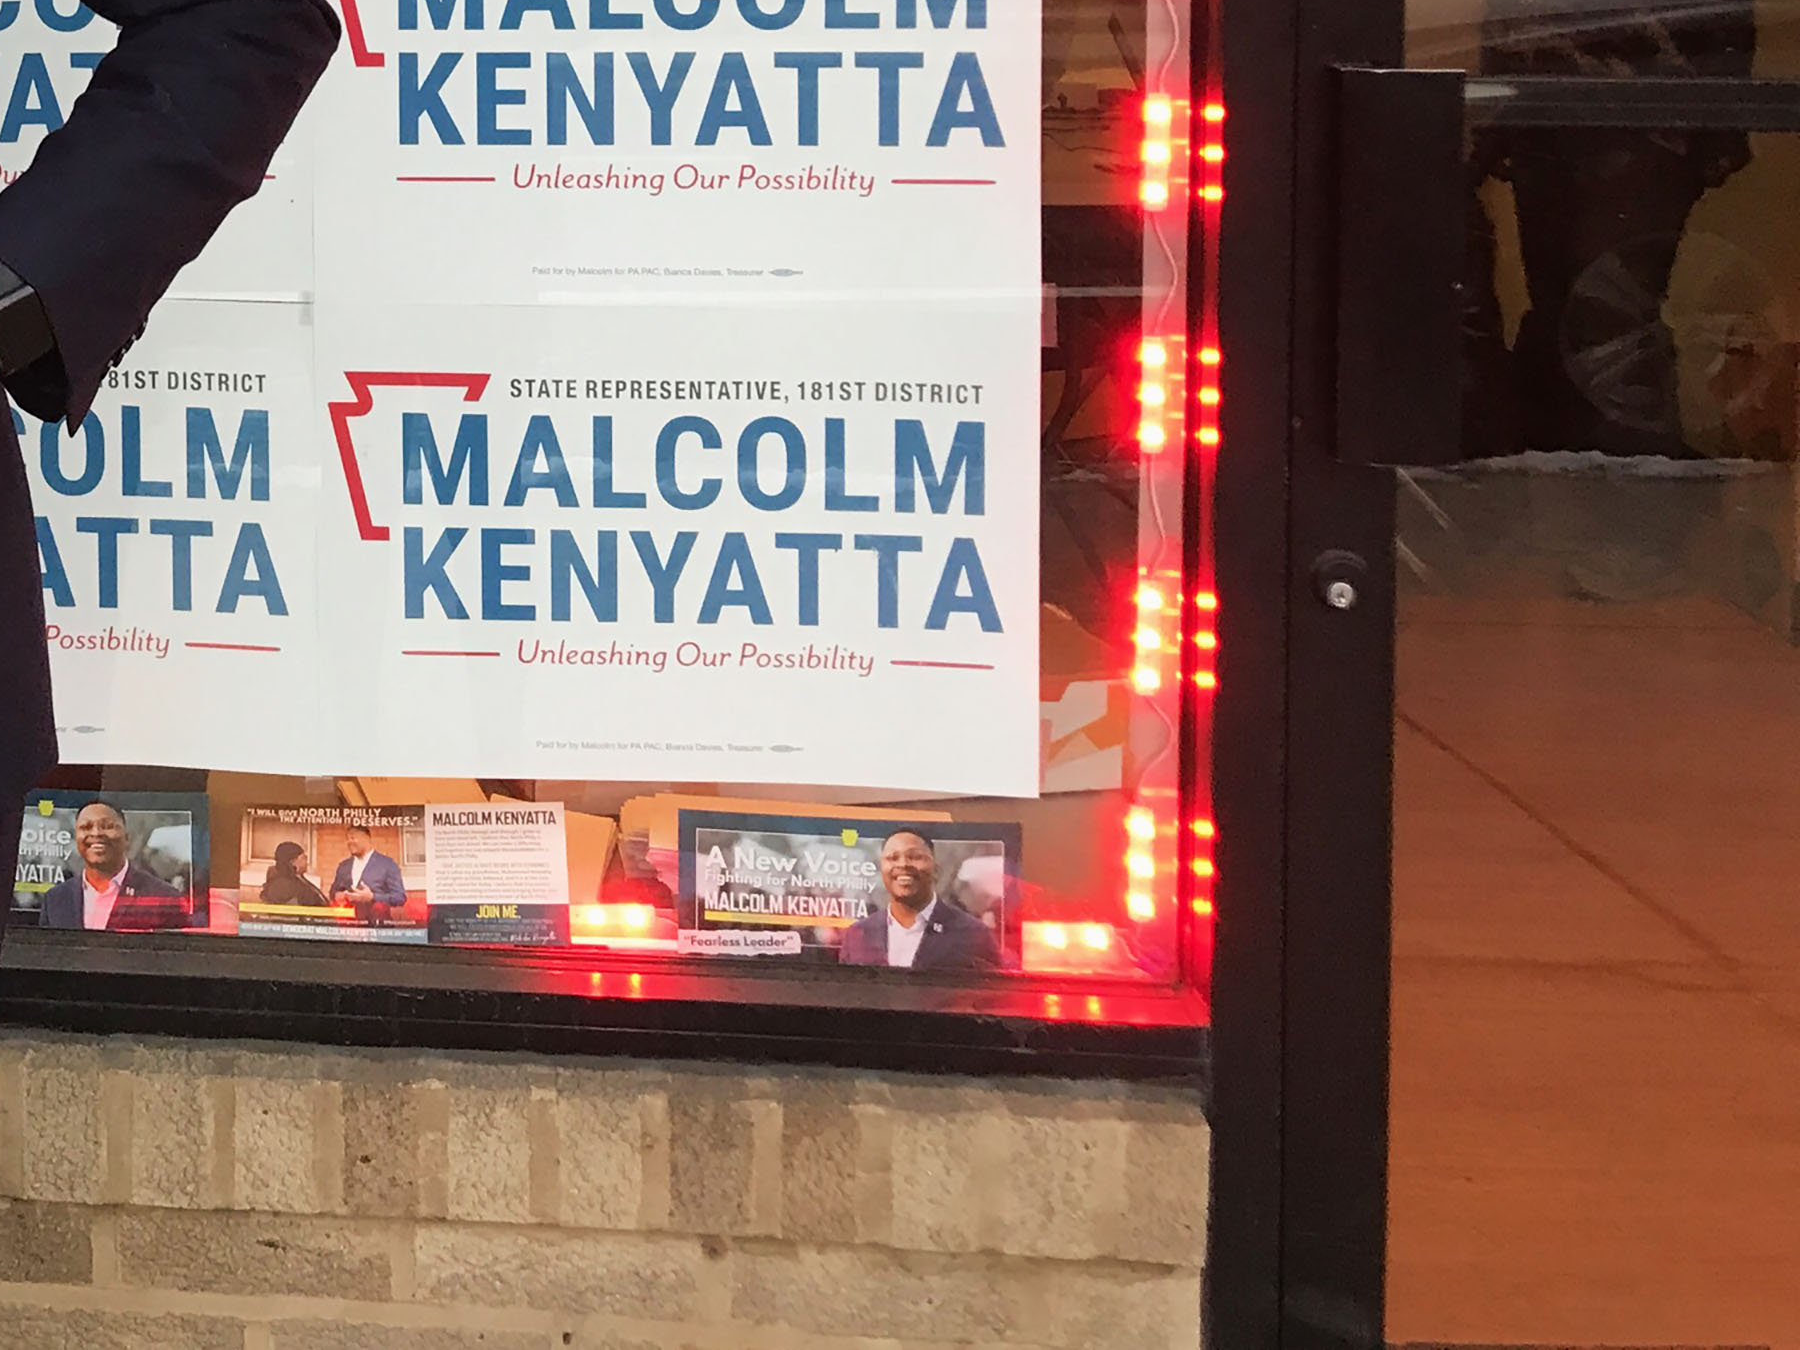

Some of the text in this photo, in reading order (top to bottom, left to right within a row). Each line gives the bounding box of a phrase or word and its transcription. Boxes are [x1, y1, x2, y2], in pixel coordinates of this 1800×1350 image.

[398, 52, 1006, 147] KENYATTA
[512, 164, 876, 197] Unleashing Our Possibility
[167, 372, 266, 393] DISTRICT
[510, 378, 984, 405] STATE REPRESENTATIVE, 181ST DISTRICT
[402, 413, 985, 516] MALCOLM
[404, 527, 1004, 633] KENYATTA
[45, 624, 170, 658] Possibility
[517, 639, 876, 677] Unleashing Our Possibility
[299, 808, 340, 818] NORTH
[343, 808, 381, 818] PHILLY
[433, 811, 556, 826] MALCOLM KENYATTA
[705, 845, 877, 877] A New Voice
[704, 869, 877, 894] Fighting for North Philly
[476, 905, 500, 919] JOIN
[705, 891, 868, 918] MALCOLM KENYATTA
